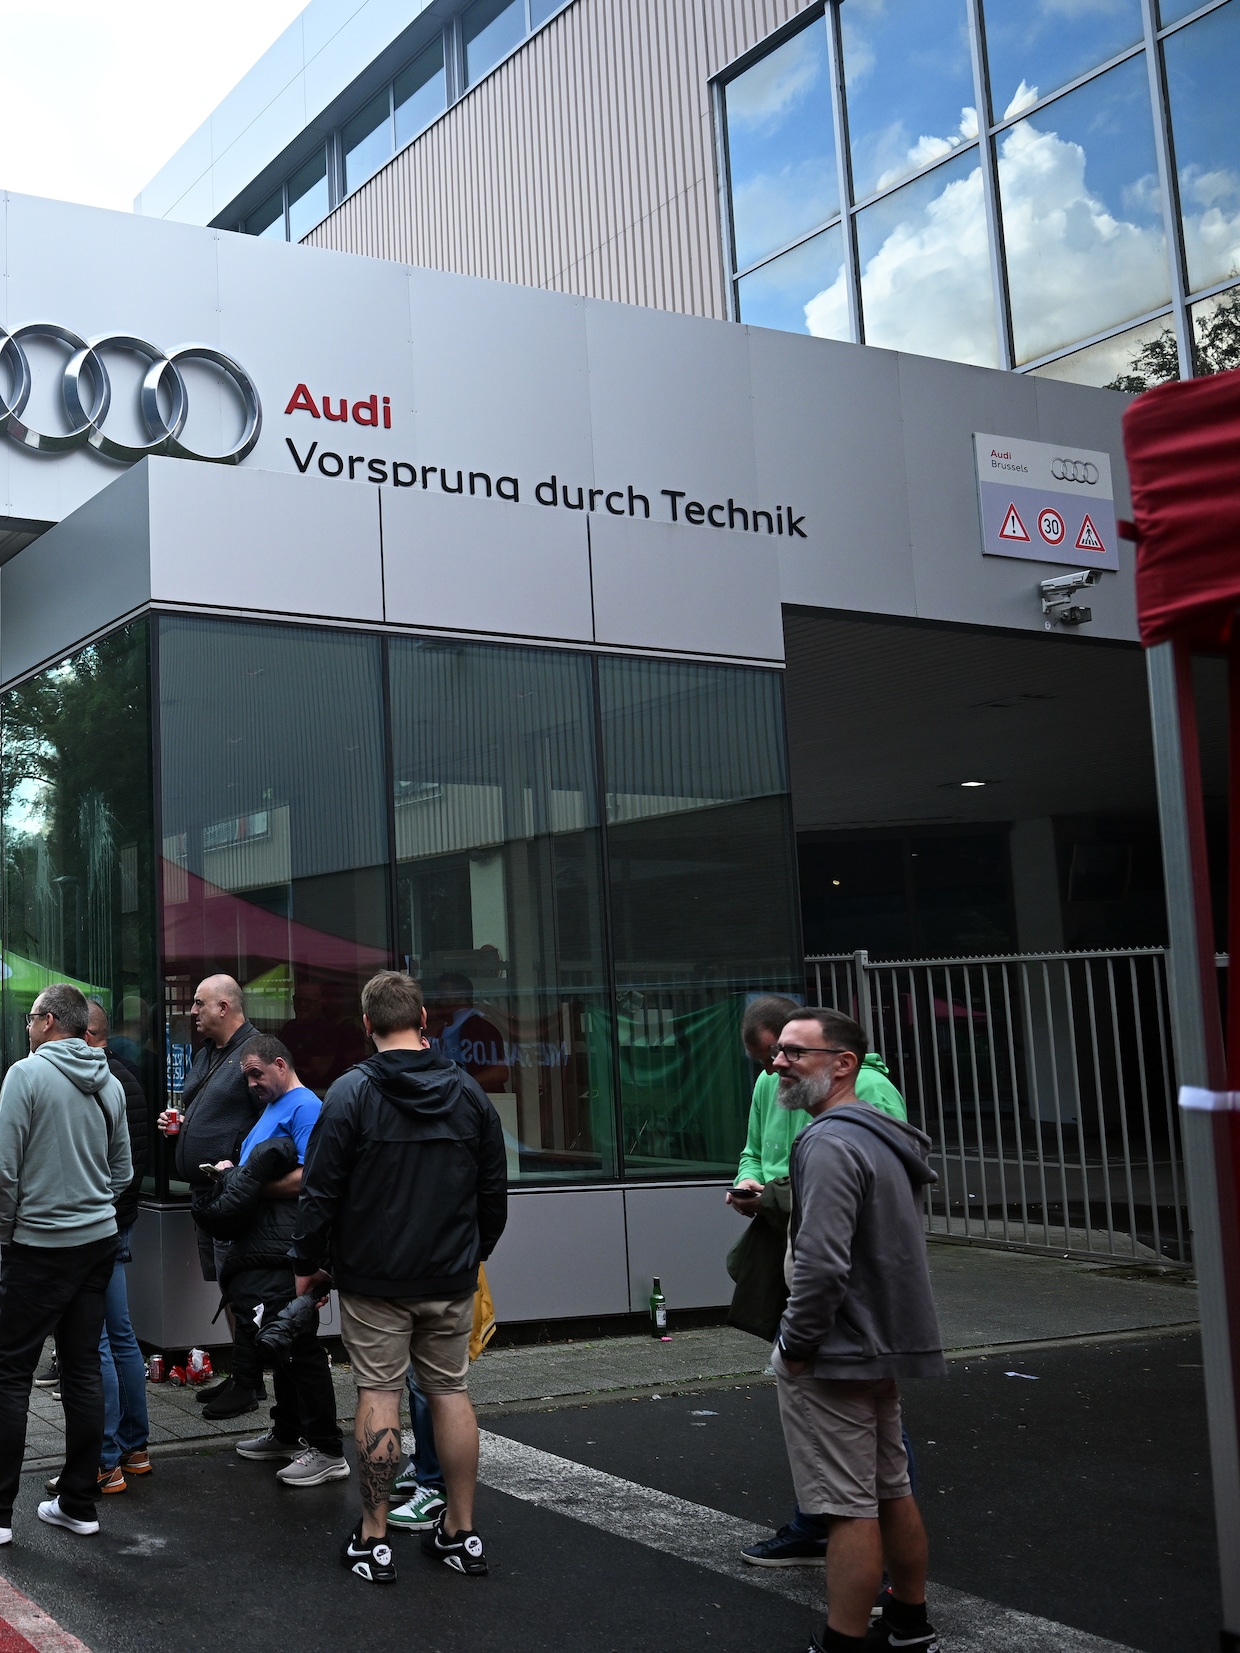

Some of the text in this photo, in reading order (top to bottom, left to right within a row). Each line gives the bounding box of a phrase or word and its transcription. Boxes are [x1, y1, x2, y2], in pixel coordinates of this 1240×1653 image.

[284, 383, 392, 429] Audi
[990, 449, 1012, 460] Audi
[991, 460, 1029, 473] Brussels
[285, 437, 808, 538] Vorsprung durch Technik
[1043, 518, 1059, 535] 30
